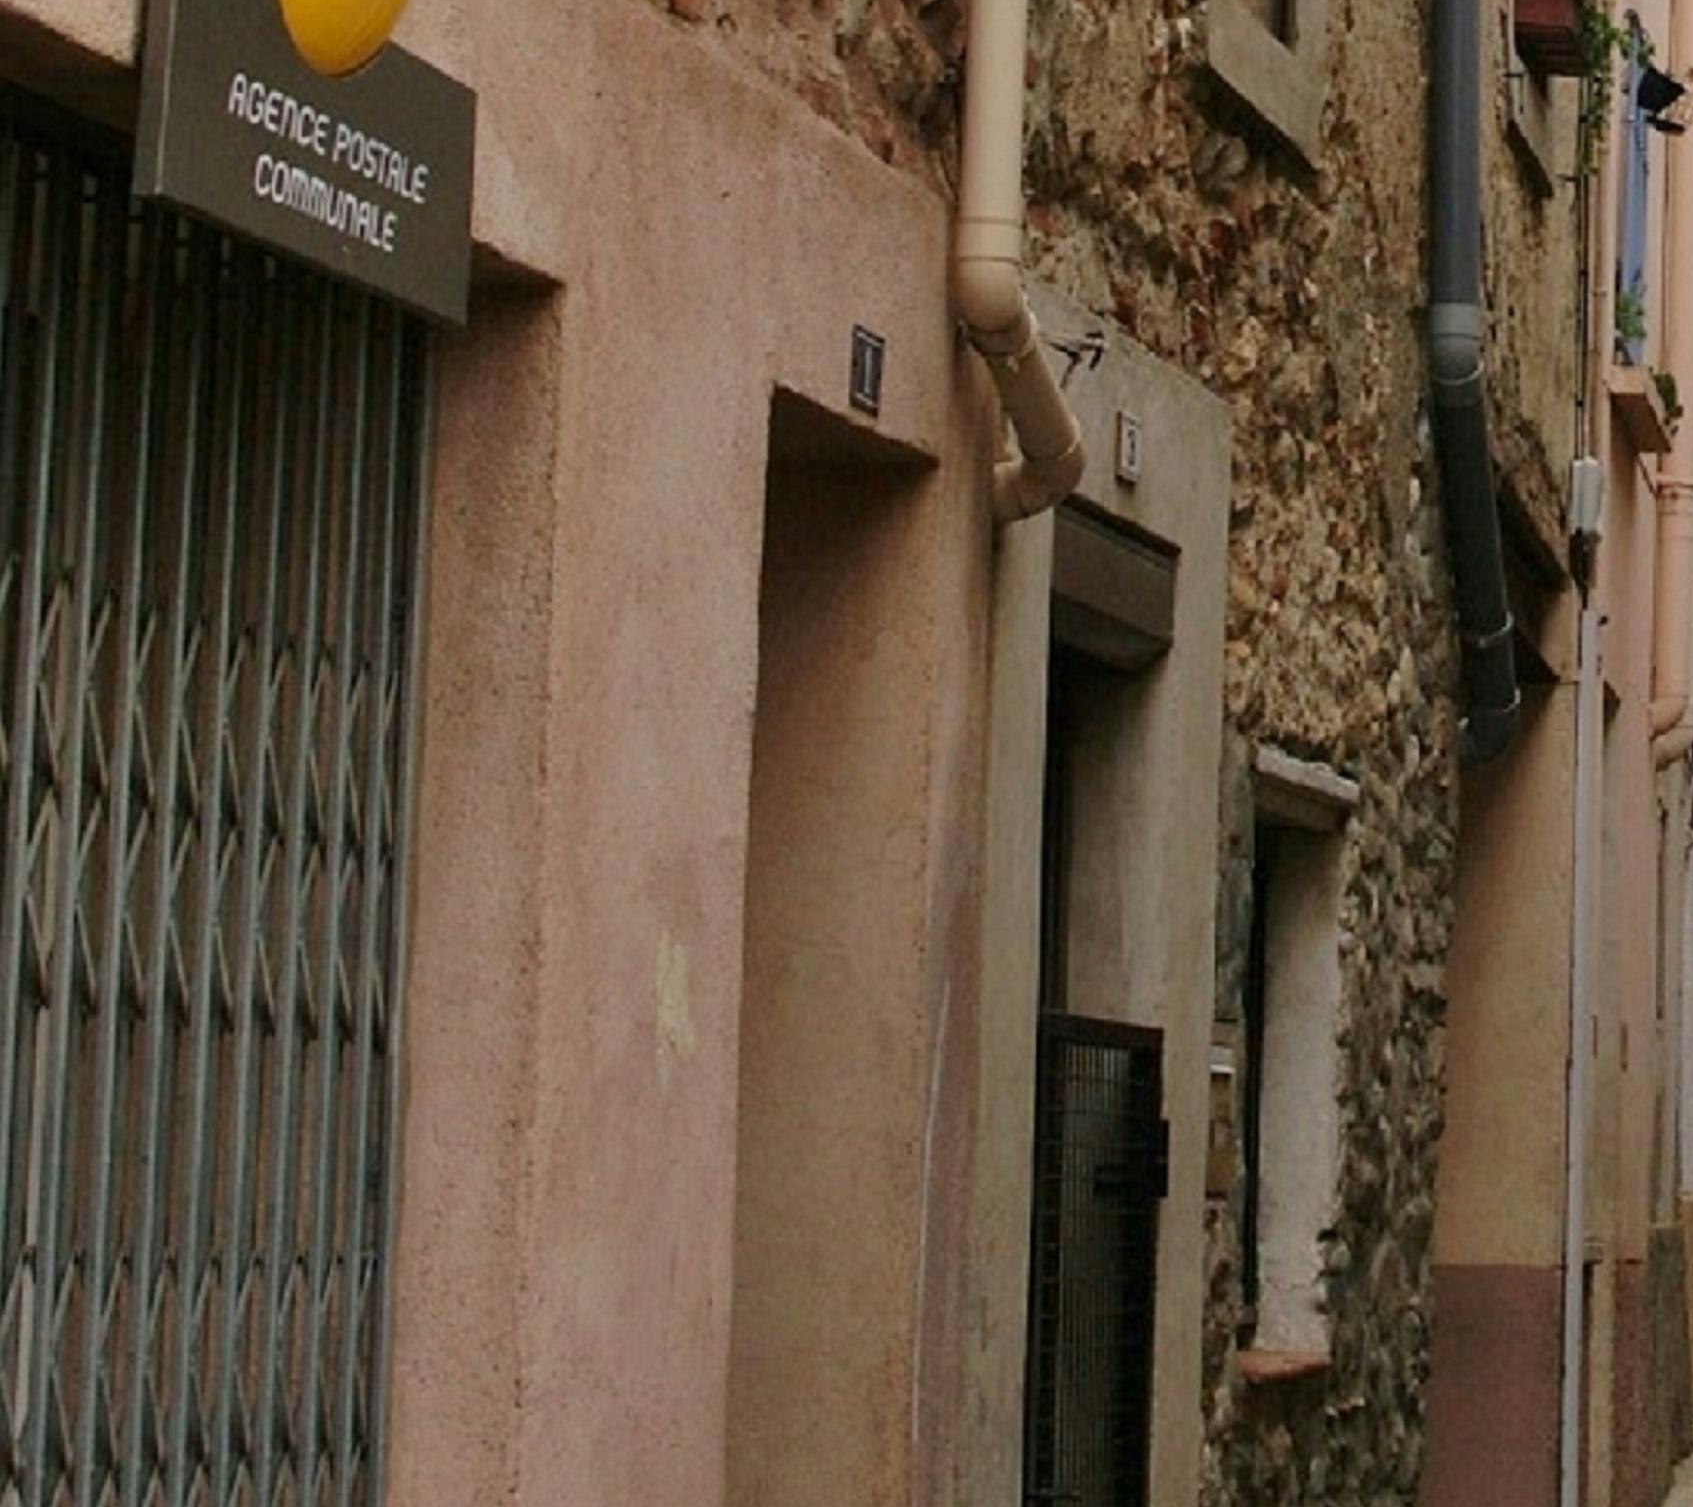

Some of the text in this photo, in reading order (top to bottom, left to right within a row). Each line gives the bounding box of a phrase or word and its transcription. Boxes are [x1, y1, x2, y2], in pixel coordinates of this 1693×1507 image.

[228, 73, 429, 204] AGENCE POSTALE
[255, 154, 397, 252] COMMUNALE
